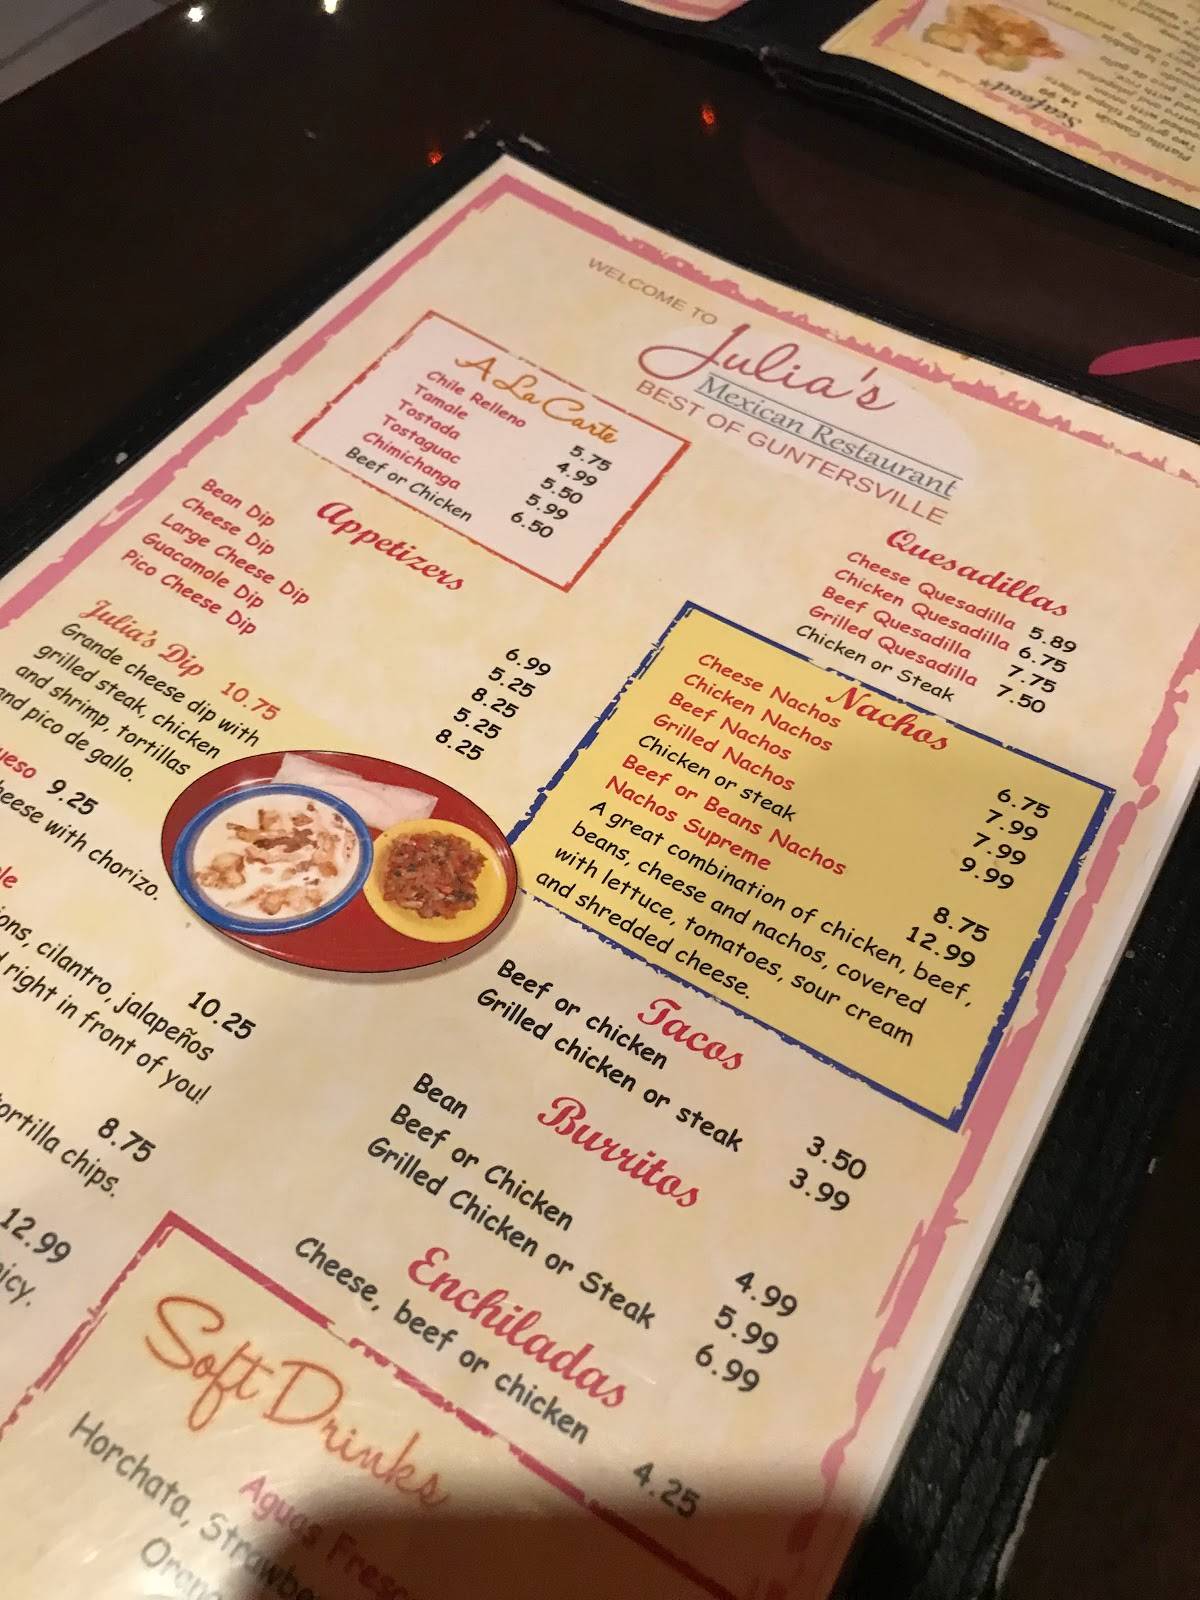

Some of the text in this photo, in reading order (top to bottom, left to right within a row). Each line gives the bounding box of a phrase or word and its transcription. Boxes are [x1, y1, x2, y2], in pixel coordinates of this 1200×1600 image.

[588, 257, 718, 325] WELCOME TO
[414, 384, 469, 421] Tamale
[426, 370, 528, 428] Chile Relleno
[454, 357, 620, 444] A La Carte
[637, 324, 896, 412] Julia's
[382, 415, 461, 465] Tostaguac
[398, 399, 461, 441] Tostada
[635, 379, 949, 526] BEST OF GUNTERSVILLE
[697, 375, 960, 498] Mexican Restaurant
[362, 431, 461, 491] Chimichanga
[540, 477, 584, 504] 5.50
[556, 462, 598, 487] 4.99
[569, 445, 613, 472] 5.75
[201, 479, 275, 527] Bean Dip
[510, 511, 554, 538] 6.50
[525, 494, 569, 521] 5.99
[142, 533, 264, 608] Guacamole Dip
[316, 501, 465, 591] Appetizers
[886, 530, 1068, 616] Quesadillas
[121, 550, 257, 635] Pico Cheese Dip
[847, 552, 1077, 653] Cheese Quesadilla 5.89
[61, 623, 260, 747] Grande cheese dip with
[79, 600, 281, 721] Julia's Dip 10.75
[488, 667, 536, 697] 5.25
[505, 649, 551, 676] 6.99
[698, 654, 842, 728] Cheese Nachos
[809, 605, 1046, 713] Grilled Quesadilla 7.50
[15, 666, 190, 775] and shrimp, tortillas
[33, 645, 221, 759] grilled steak, chicken
[471, 687, 520, 718] 8.25
[825, 687, 948, 750] Nachos
[21, 706, 64, 734] pico
[64, 731, 90, 751] de
[84, 749, 134, 782] gallo.
[653, 714, 796, 791] Grilled Nachos
[46, 779, 98, 815] 9.25
[605, 776, 772, 871] Nachos Supreme
[985, 809, 1038, 841] 7.99
[997, 789, 1050, 819] 6.75
[45, 819, 87, 852] with
[88, 848, 158, 900] chorizo.
[959, 857, 1014, 889] 9.99
[536, 872, 749, 999] and shredded cheese.
[572, 821, 927, 1015] beans, cheese and nachos, covered
[590, 802, 972, 1008] A great combination of chicken, beef,
[933, 907, 989, 943] 8.75
[0, 906, 214, 1061] ons, cilantro, jalapeños
[555, 848, 914, 1047] with lettuce, tomatoes, sour cream
[906, 926, 976, 968] 12.99
[3, 965, 212, 1104] right in front of you!
[188, 991, 256, 1039] 10.25
[637, 998, 745, 1071] Tacos
[413, 1073, 469, 1119] Bean
[477, 988, 743, 1152] Grilled chicken or steak
[0, 1093, 119, 1197] ortilla chips.
[98, 1118, 156, 1162] 8.75
[390, 1103, 574, 1232] Beef or Chicken
[537, 1096, 700, 1208] Burritos
[805, 1136, 867, 1180] 3.50
[789, 1168, 851, 1212] 3.99
[0, 1208, 72, 1263] 12.99
[407, 1246, 627, 1408] Enchiladas
[714, 1304, 780, 1355] 5.99
[734, 1271, 798, 1317] 4.99
[295, 1237, 589, 1446] Cheese, beef or chicken
[695, 1344, 760, 1393] 6.99
[143, 1295, 450, 1508] Soft Drinks
[69, 1411, 191, 1528] Horchata,
[633, 1462, 700, 1519] 4.25
